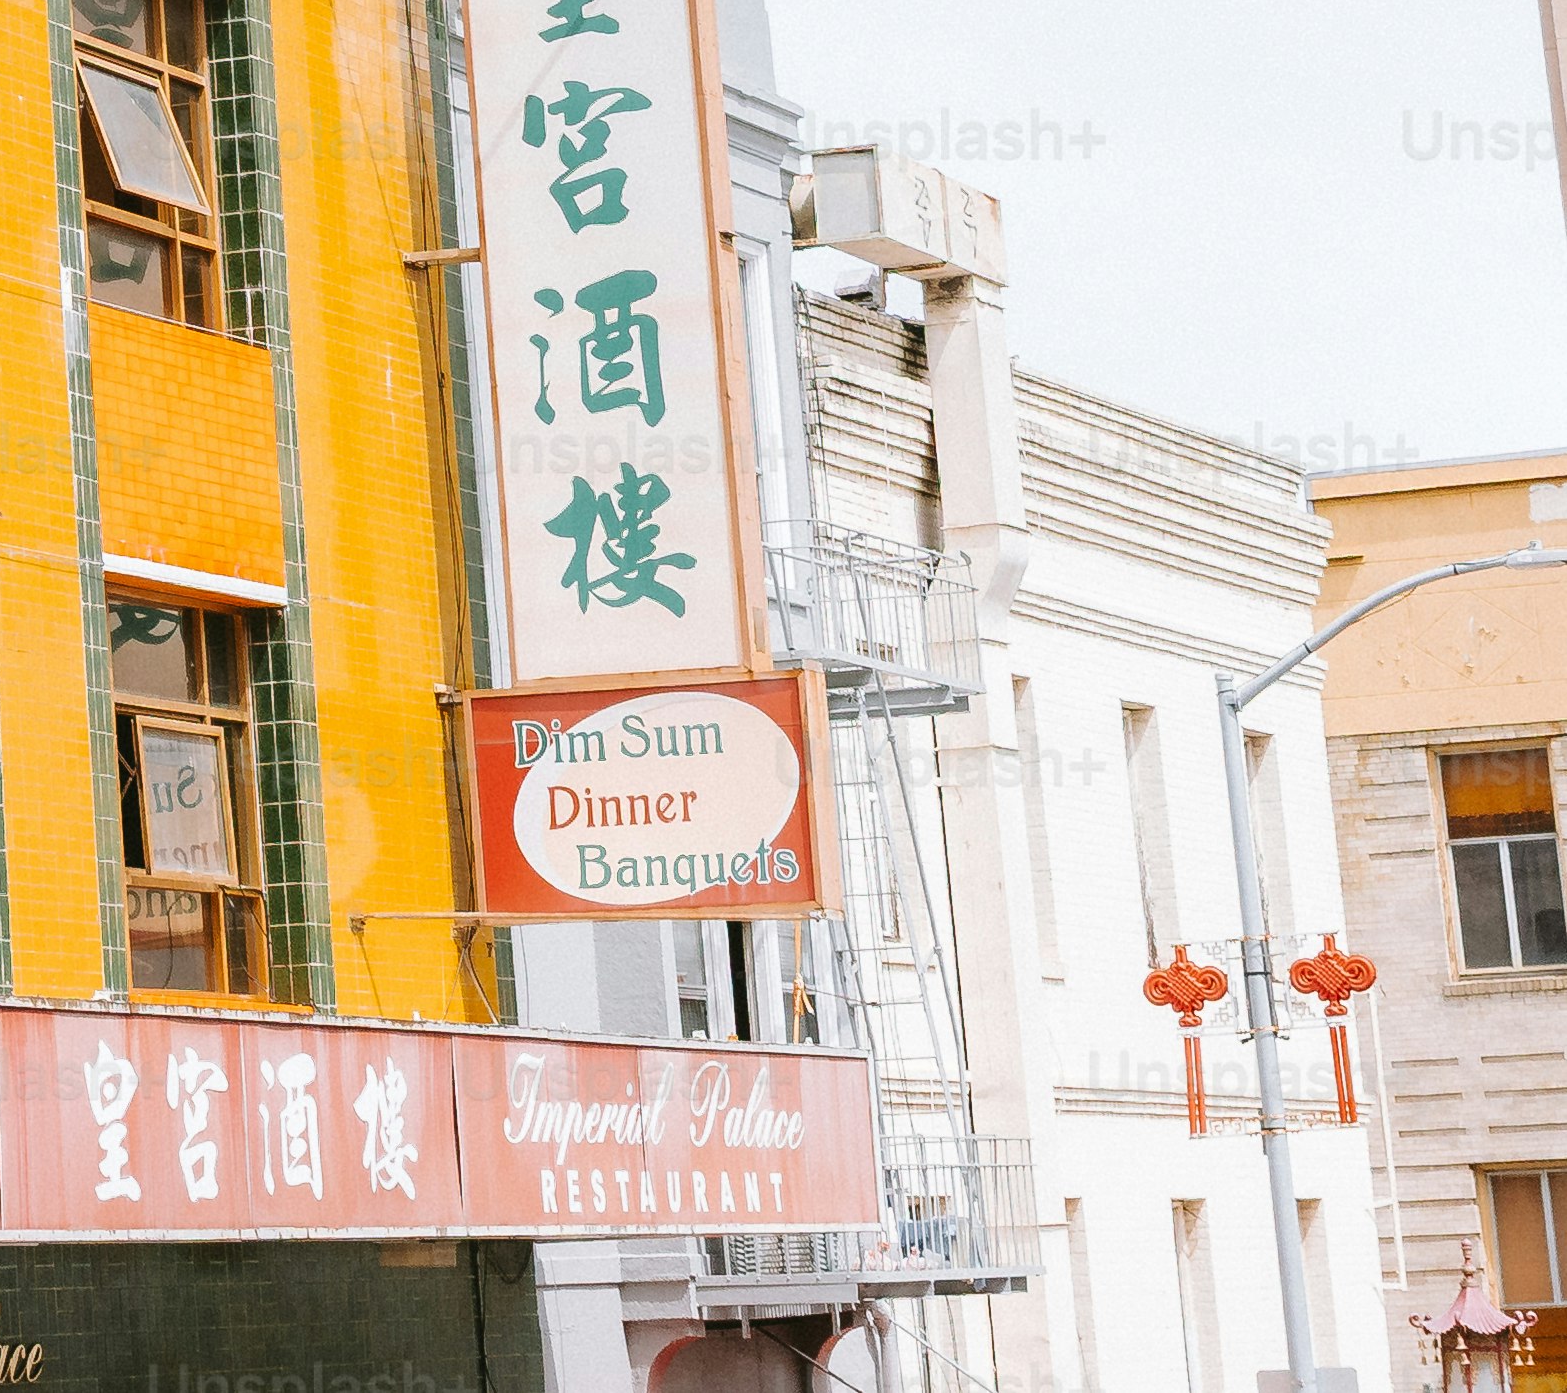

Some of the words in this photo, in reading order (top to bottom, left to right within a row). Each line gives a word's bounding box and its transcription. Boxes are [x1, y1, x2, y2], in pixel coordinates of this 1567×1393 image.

[513, 718, 607, 770] Dim
[619, 713, 725, 761] Sum
[547, 785, 700, 833] Dinner
[574, 837, 801, 896] Banquets
[502, 1051, 677, 1168] Imperial
[688, 1058, 806, 1154] Palace
[540, 1168, 787, 1216] RESTAURANT
